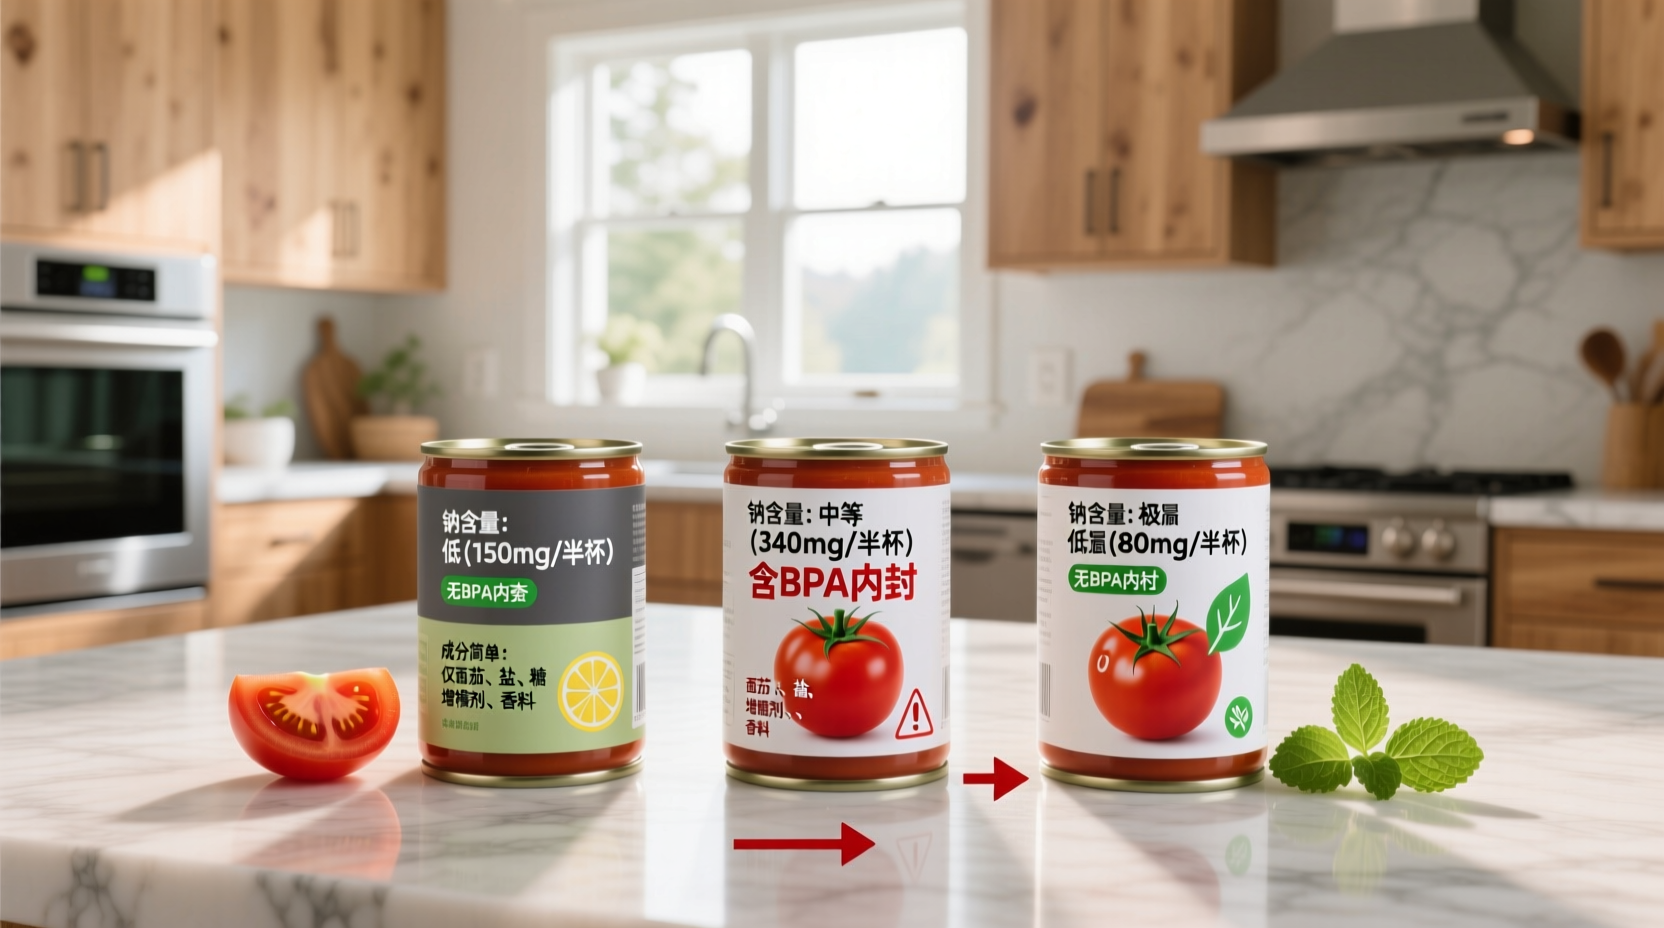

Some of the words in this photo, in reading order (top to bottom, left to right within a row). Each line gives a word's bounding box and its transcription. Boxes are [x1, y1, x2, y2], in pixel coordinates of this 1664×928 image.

[442, 537, 614, 570] 低(150mg/半杯)
[751, 528, 913, 561] (340mg/半杯)
[749, 561, 917, 602] 含BPA内封
